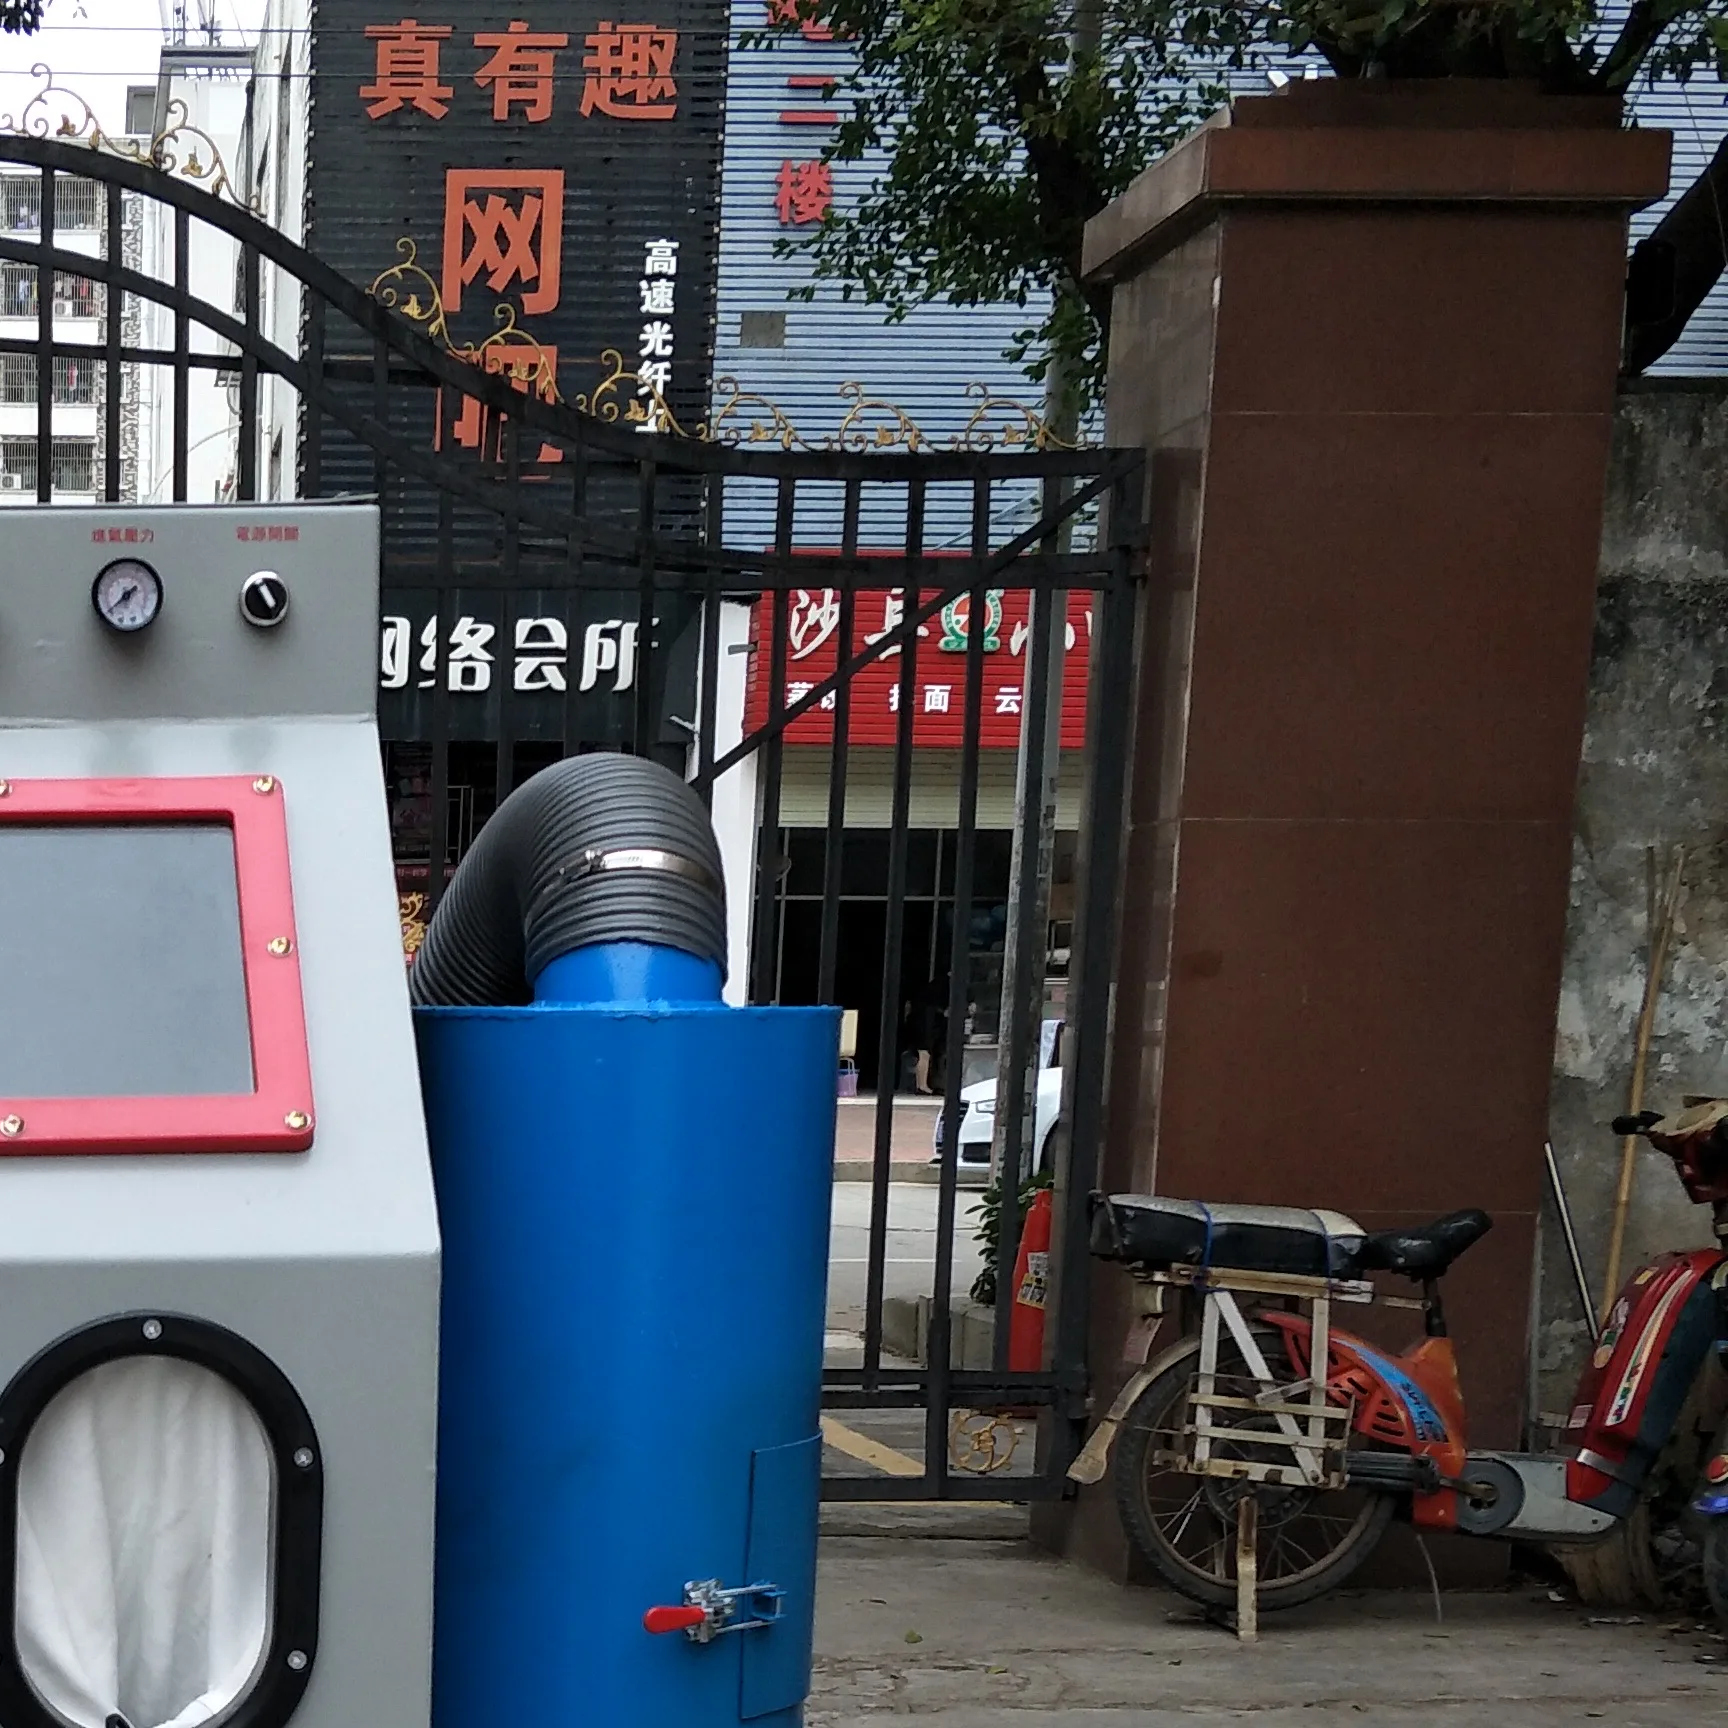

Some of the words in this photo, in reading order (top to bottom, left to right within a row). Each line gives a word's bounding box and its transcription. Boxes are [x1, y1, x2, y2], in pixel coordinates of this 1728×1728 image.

[359, 20, 679, 123] 真有趣
[381, 615, 660, 692] 网络会所
